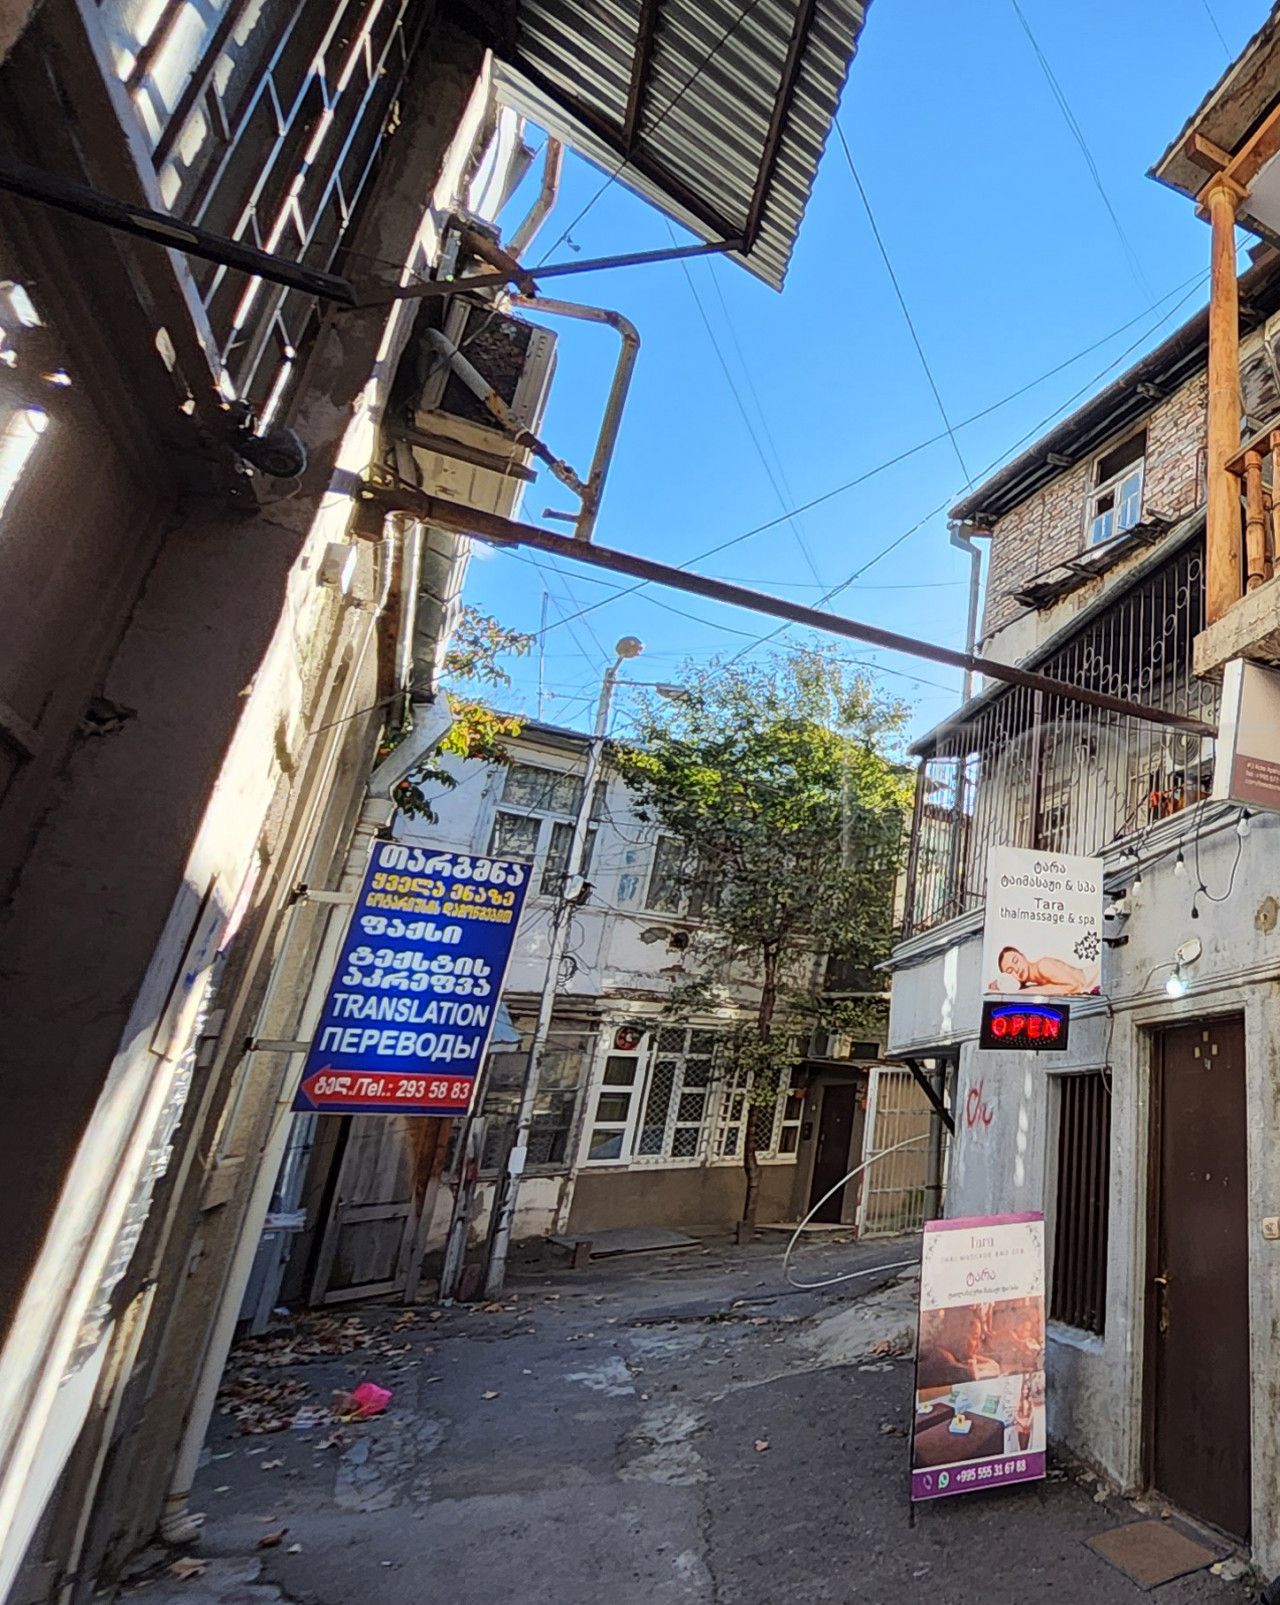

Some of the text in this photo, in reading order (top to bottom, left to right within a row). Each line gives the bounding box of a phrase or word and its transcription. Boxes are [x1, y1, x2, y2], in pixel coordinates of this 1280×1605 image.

[378, 844, 525, 887] თარგმნა
[1033, 861, 1067, 875] ტარა
[371, 872, 516, 907] ყველა ენაზე
[1000, 875, 1096, 894] ტაიმასაჟი & სპა
[1034, 897, 1065, 911] Tara
[1000, 907, 1096, 926] thaimassage & spa
[360, 915, 463, 945] ფაქსი
[348, 946, 492, 978] ტექსტის
[342, 966, 492, 997] აკრეფვა
[332, 993, 491, 1028] TRANSLATION
[991, 1015, 1061, 1039] OPEN
[319, 1026, 481, 1062] ПЕРЕВОДЫ
[396, 1079, 426, 1099] 293
[429, 1081, 448, 1099] 58
[451, 1082, 471, 1100] 83
[966, 1267, 997, 1287] ტარა
[977, 1464, 993, 1480] 555
